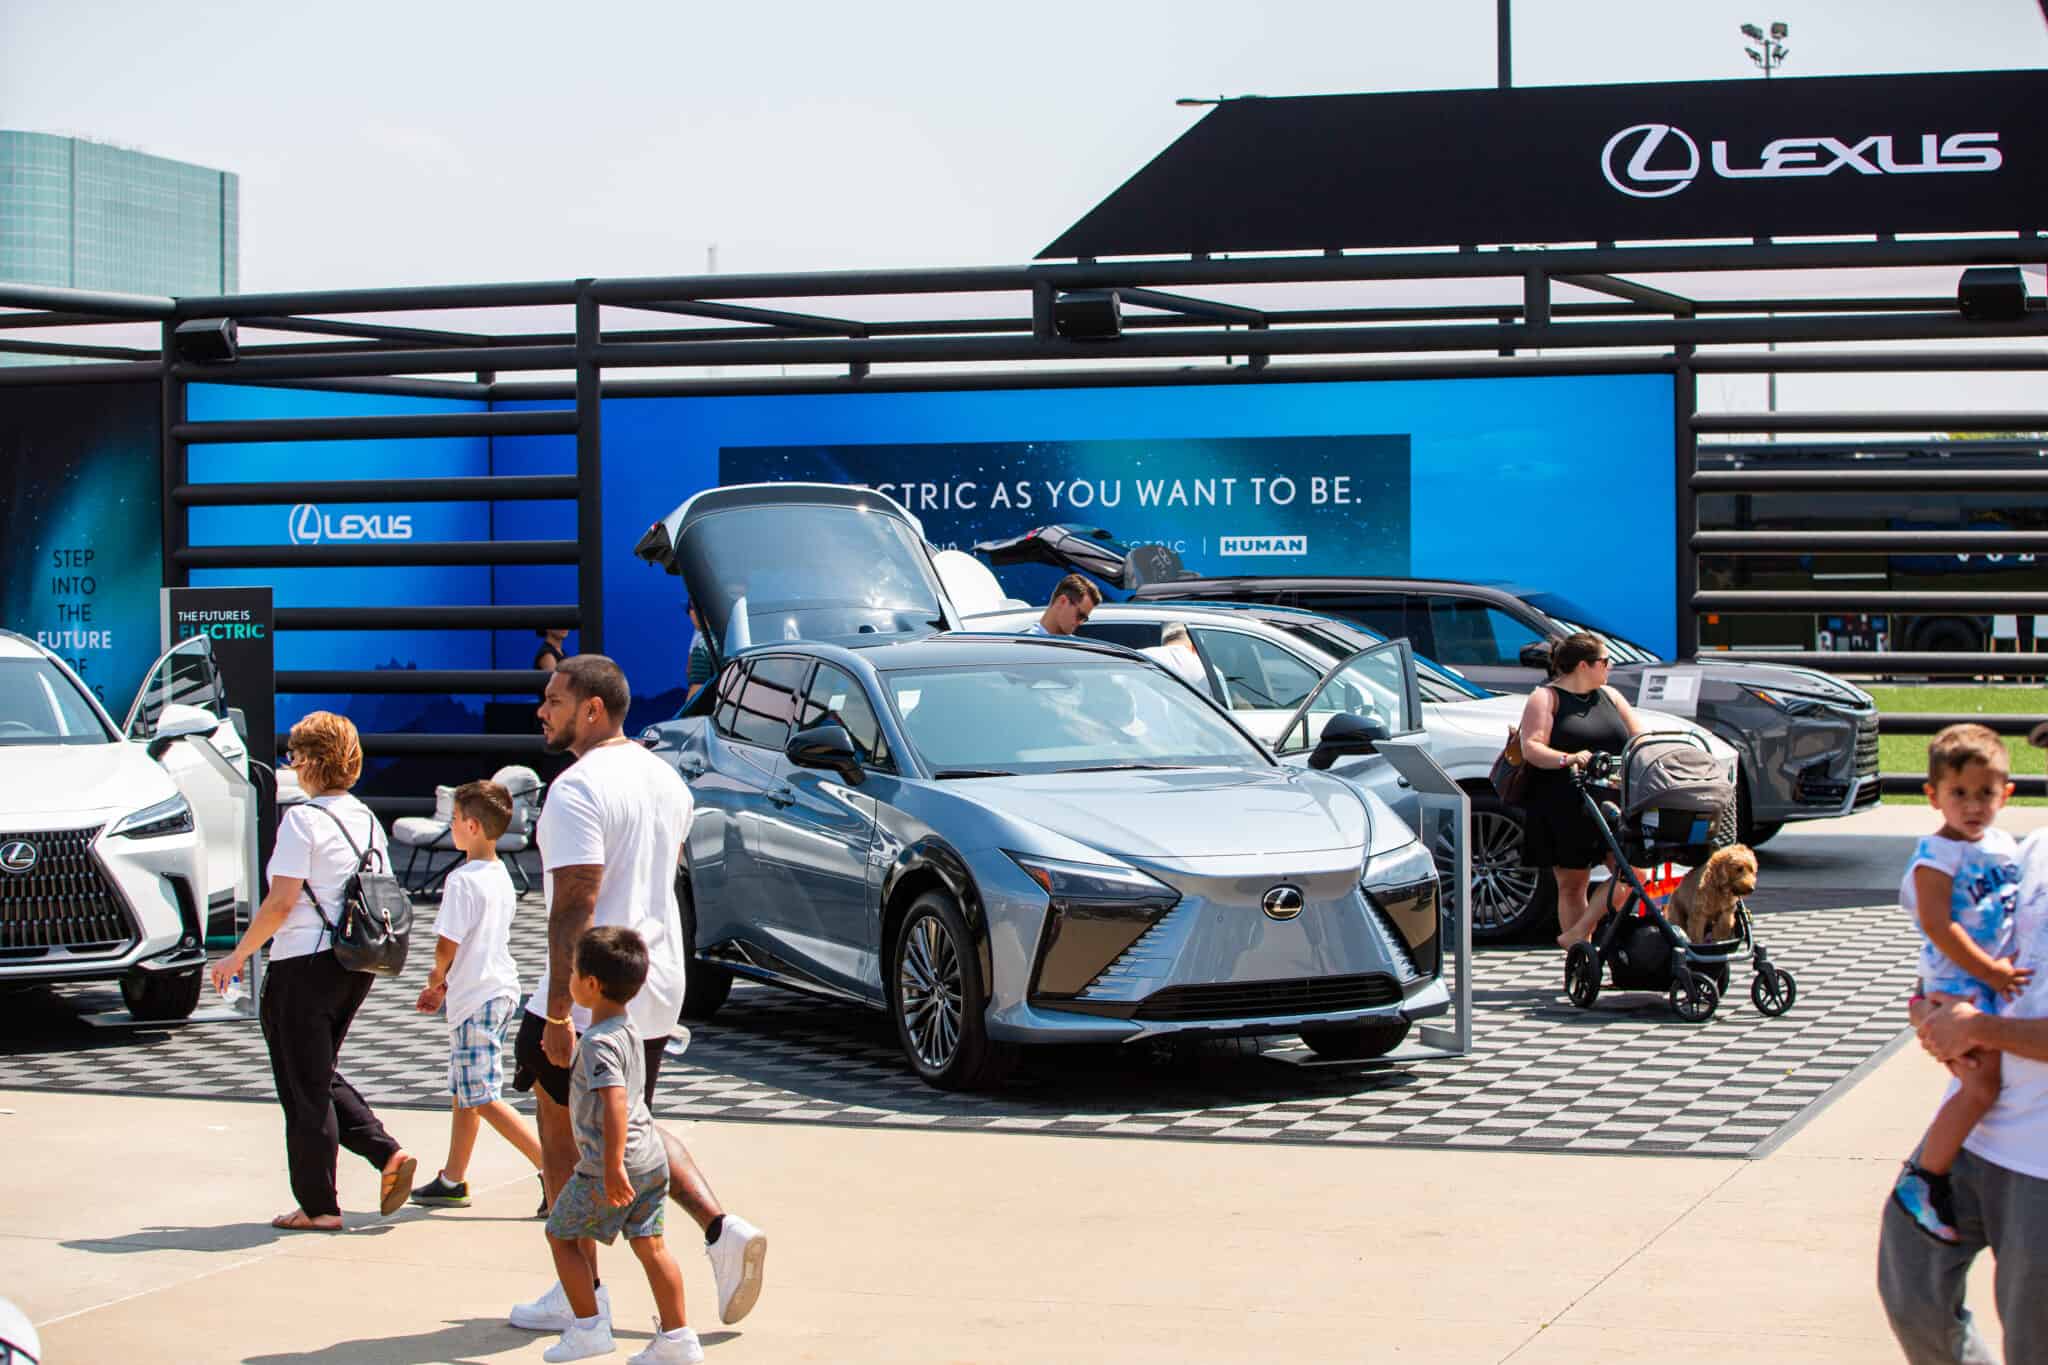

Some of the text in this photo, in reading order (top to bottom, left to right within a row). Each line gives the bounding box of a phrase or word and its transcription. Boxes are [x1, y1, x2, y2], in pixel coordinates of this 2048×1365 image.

[1710, 132, 2003, 179] LEXUS
[858, 476, 1363, 509] TRIC AS YOU WANT TO BE.
[324, 514, 412, 539] LEXUS
[1224, 539, 1302, 552] HUMAN
[53, 550, 95, 568] STEP
[52, 576, 96, 595] INTO
[58, 604, 91, 622] THE
[178, 610, 250, 622] THE FUTURE IS
[38, 631, 113, 649] FUTURE
